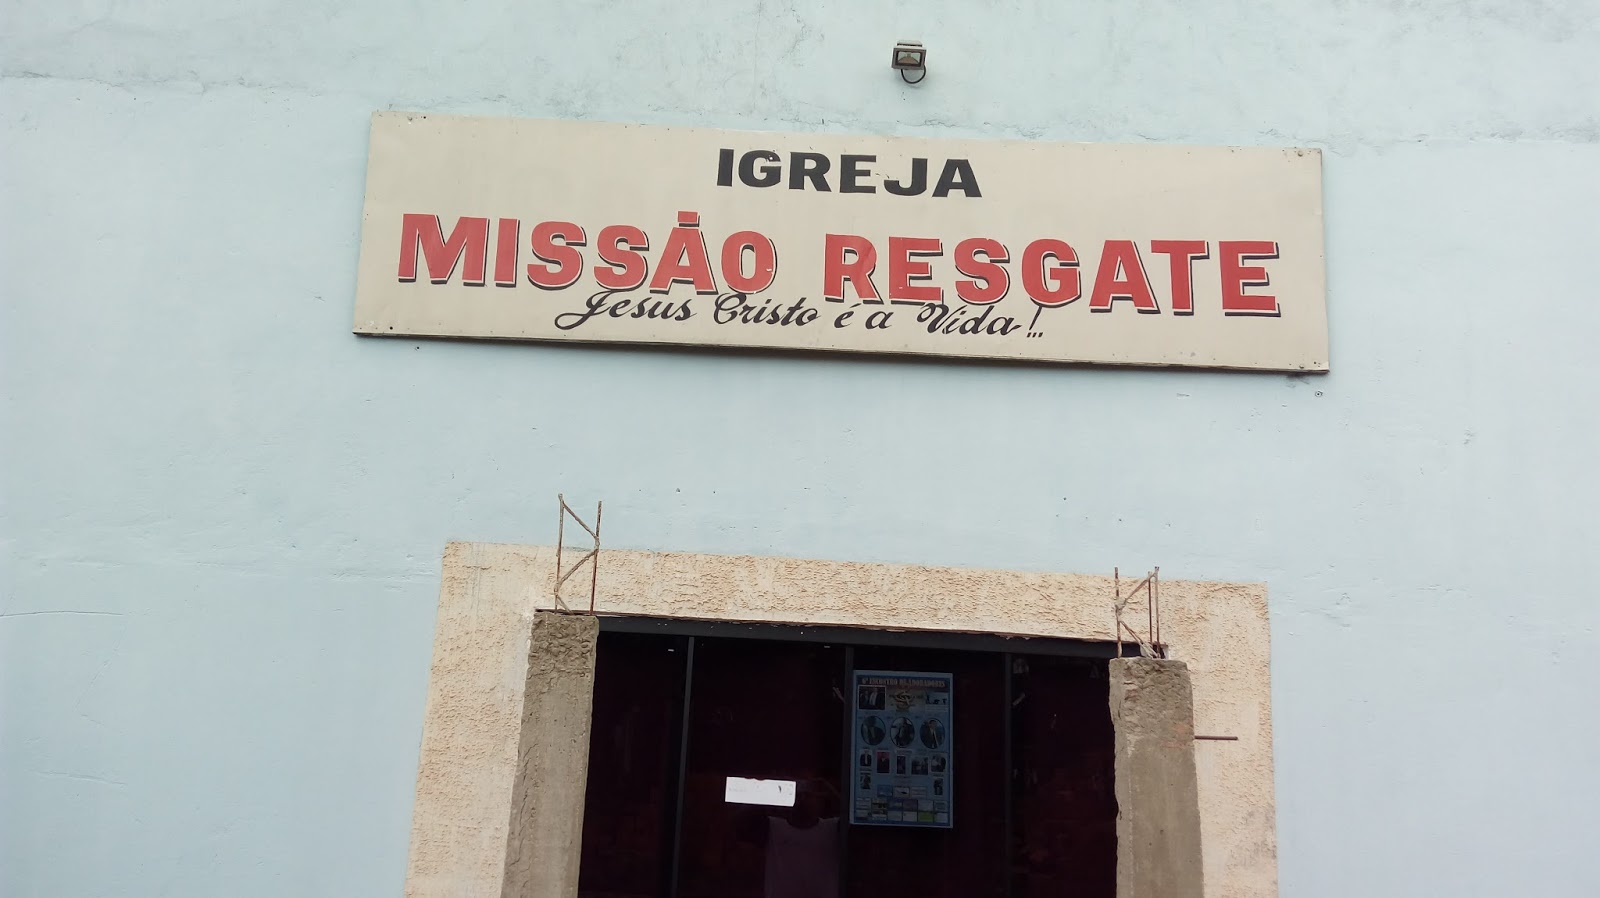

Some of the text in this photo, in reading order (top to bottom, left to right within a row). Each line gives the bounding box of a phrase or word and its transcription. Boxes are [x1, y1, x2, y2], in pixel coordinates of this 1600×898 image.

[716, 147, 983, 198] IGREJA
[397, 210, 1282, 318] MISSÃO RESGATE
[554, 290, 698, 331] Jesus
[713, 291, 823, 328] Cristo
[834, 302, 861, 329] é
[865, 311, 895, 330] a
